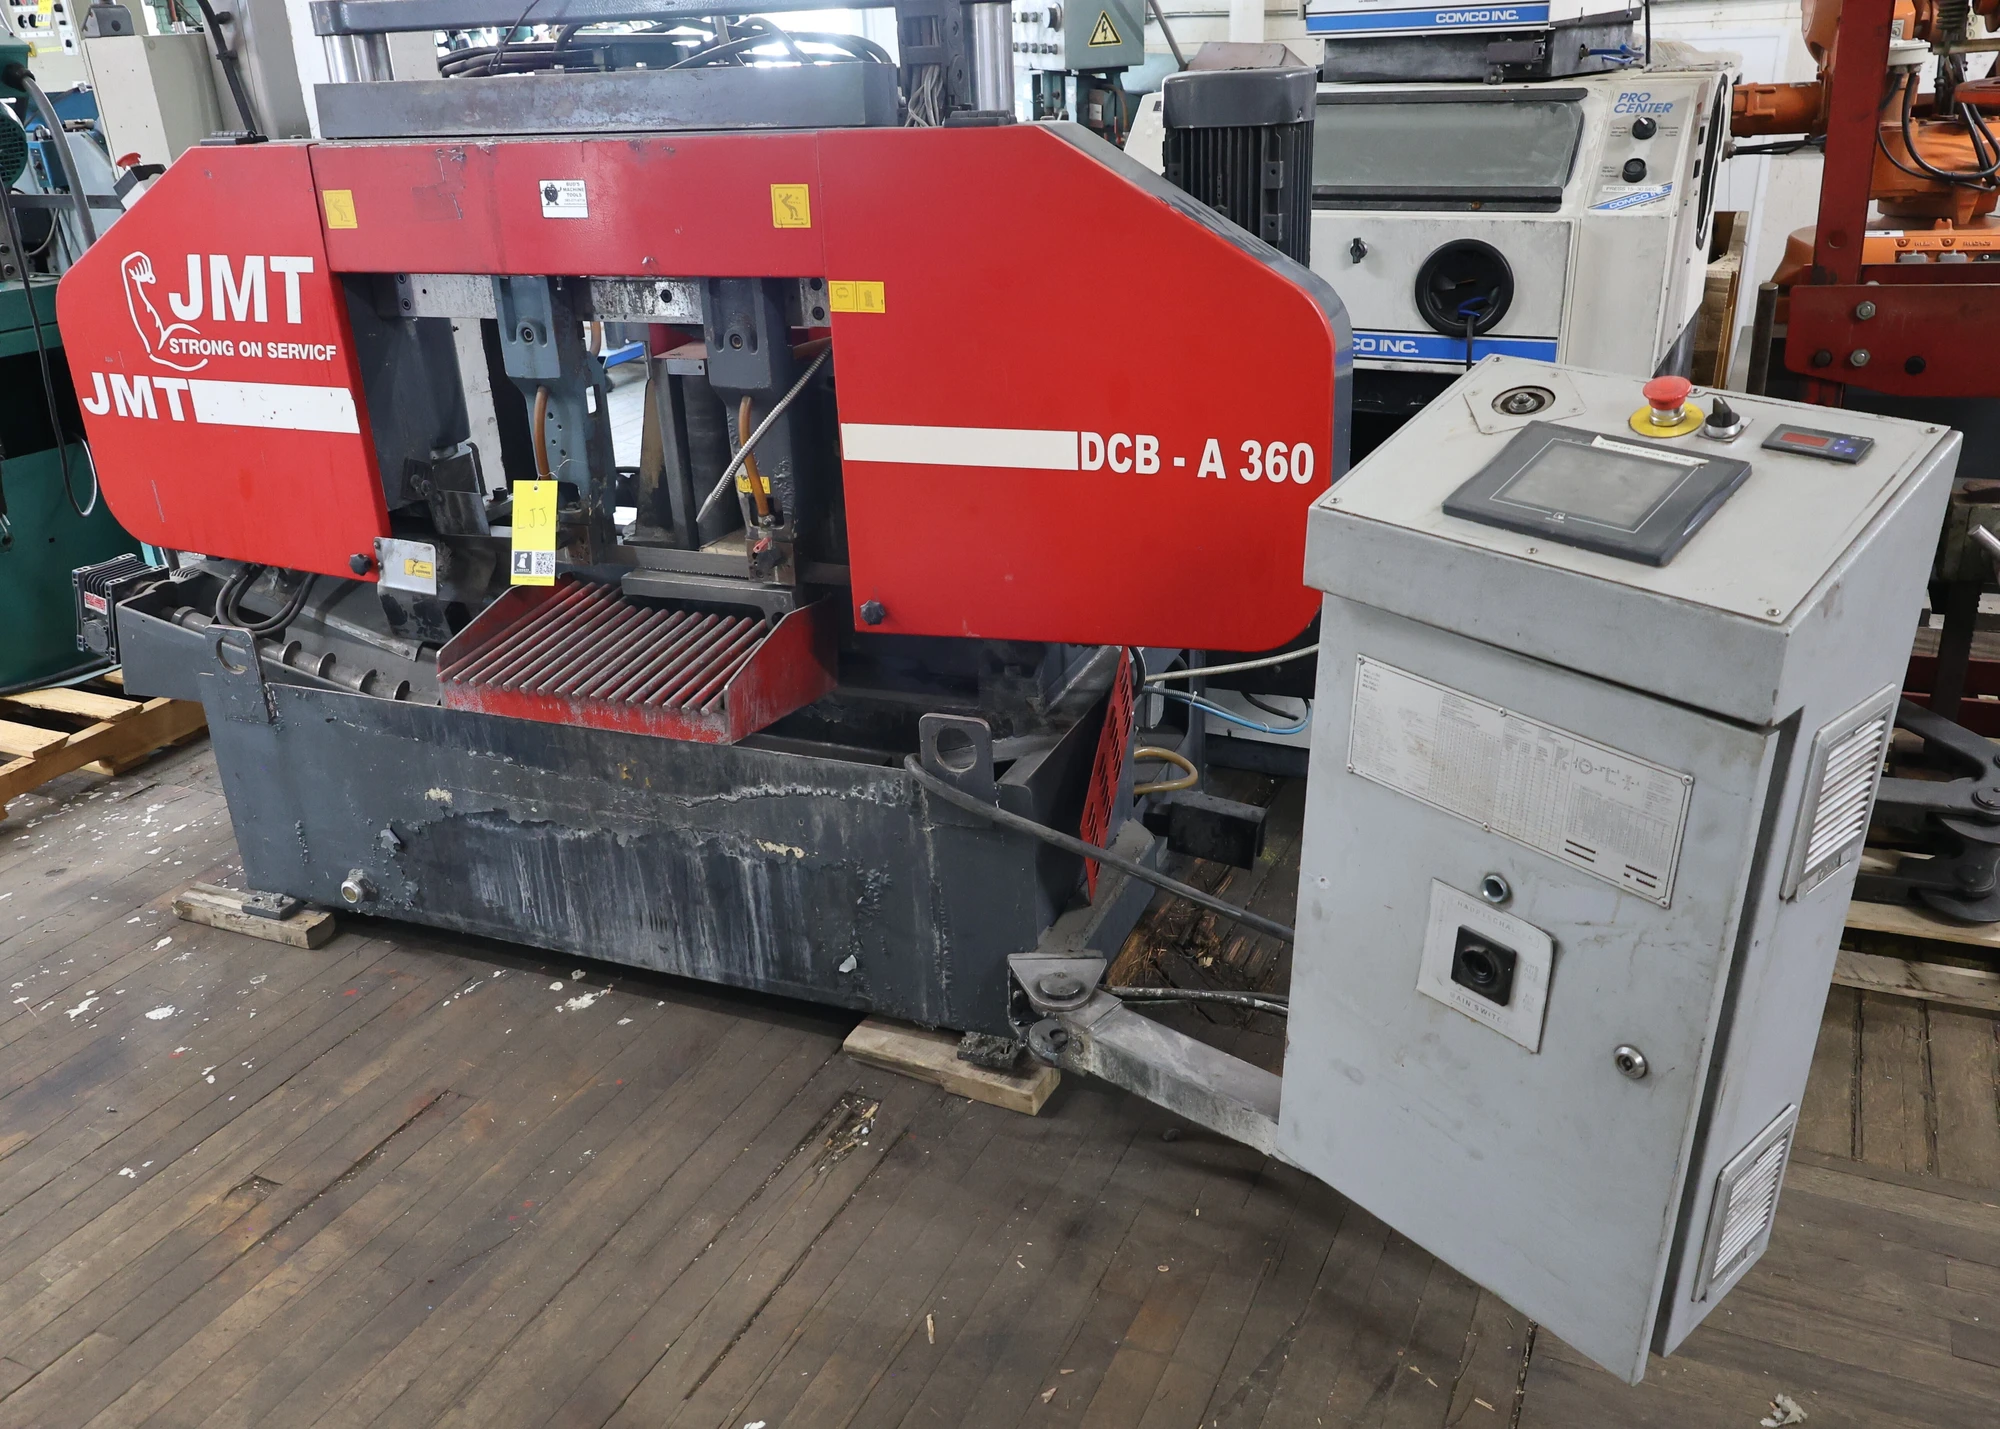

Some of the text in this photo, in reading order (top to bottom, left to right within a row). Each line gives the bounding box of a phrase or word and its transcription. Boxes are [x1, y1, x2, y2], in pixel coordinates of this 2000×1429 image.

[1435, 9, 1519, 23] COMCO INC.
[1617, 92, 1651, 103] PRO
[1613, 103, 1673, 114] CENTER
[1609, 193, 1650, 209] COMCO
[168, 254, 314, 324] JMT
[169, 338, 234, 357] STRONG
[239, 341, 263, 358] ON
[1379, 339, 1419, 354] INC.
[82, 372, 190, 422] JMT
[1081, 431, 1160, 475] DCB
[1196, 438, 1227, 480] A
[1239, 440, 1315, 485] 360
